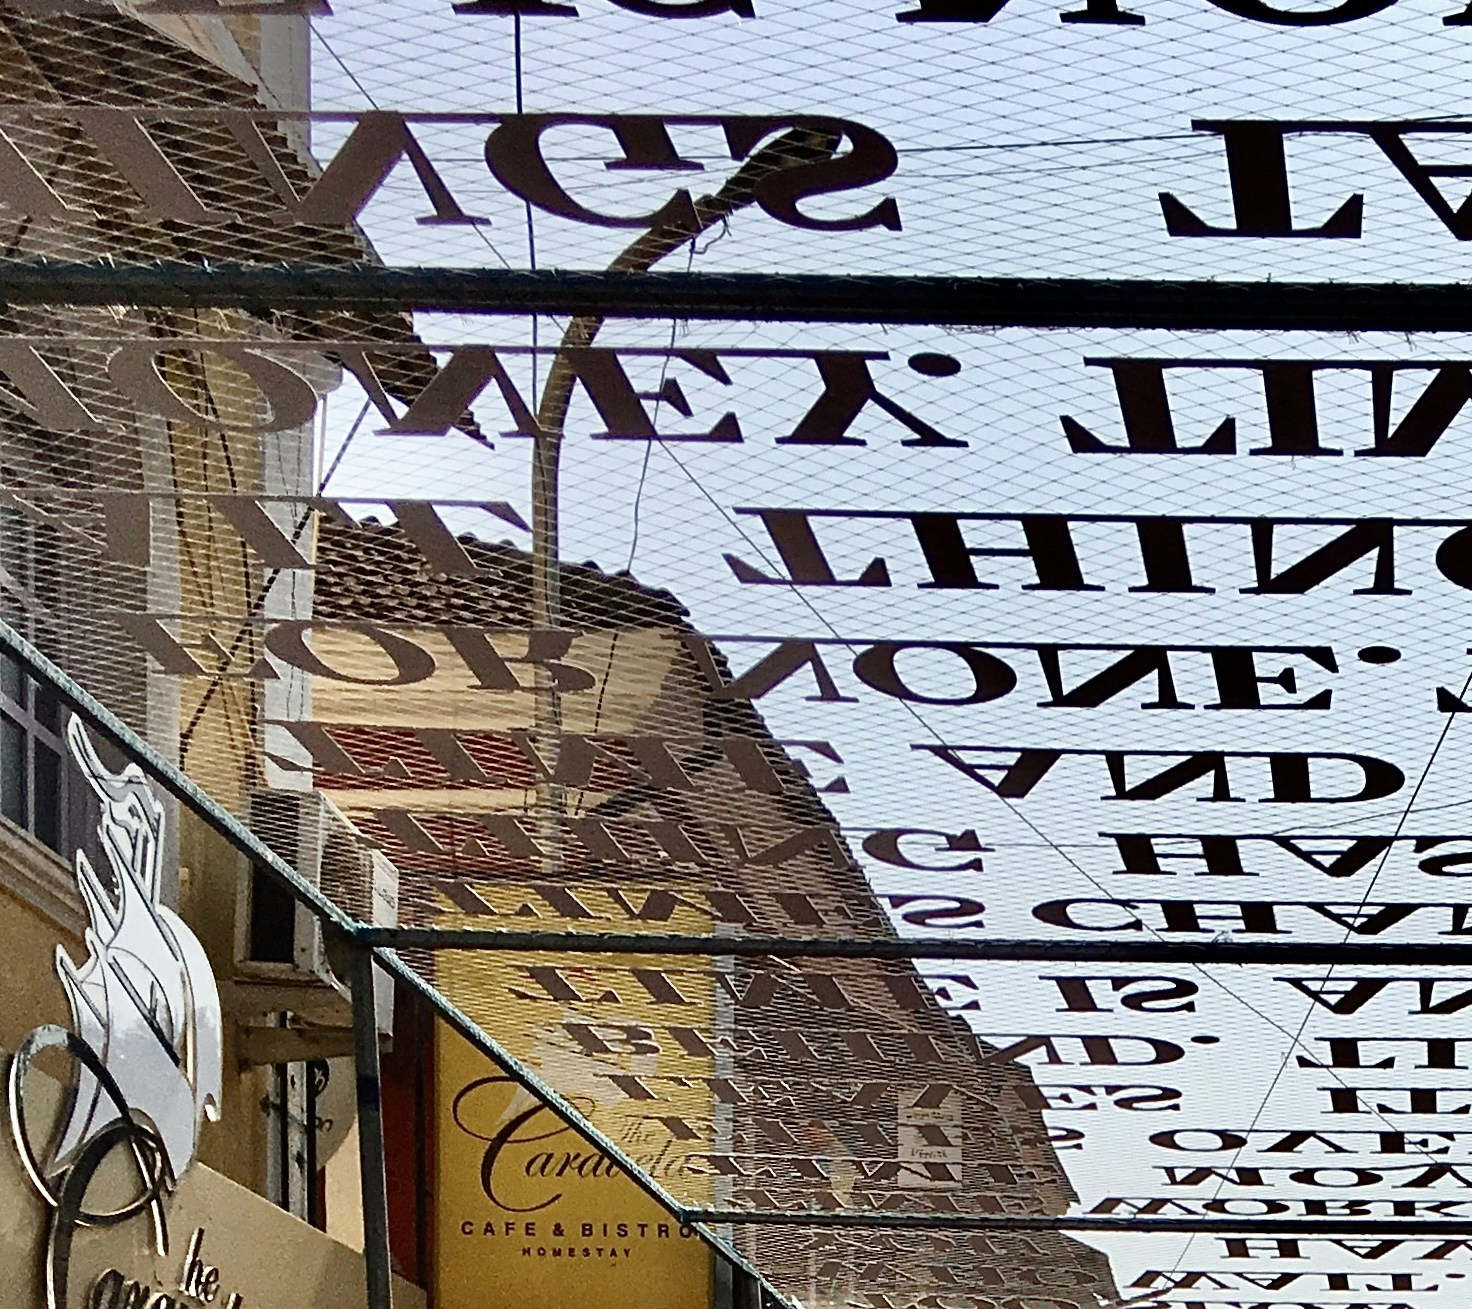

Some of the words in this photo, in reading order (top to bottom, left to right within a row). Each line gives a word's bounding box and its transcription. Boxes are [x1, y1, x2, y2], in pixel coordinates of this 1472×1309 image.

[460, 1220, 538, 1238] CAFE
[551, 1222, 566, 1238] &
[580, 1221, 700, 1240] BISTRO
[521, 1246, 632, 1259] HOMESTAY
